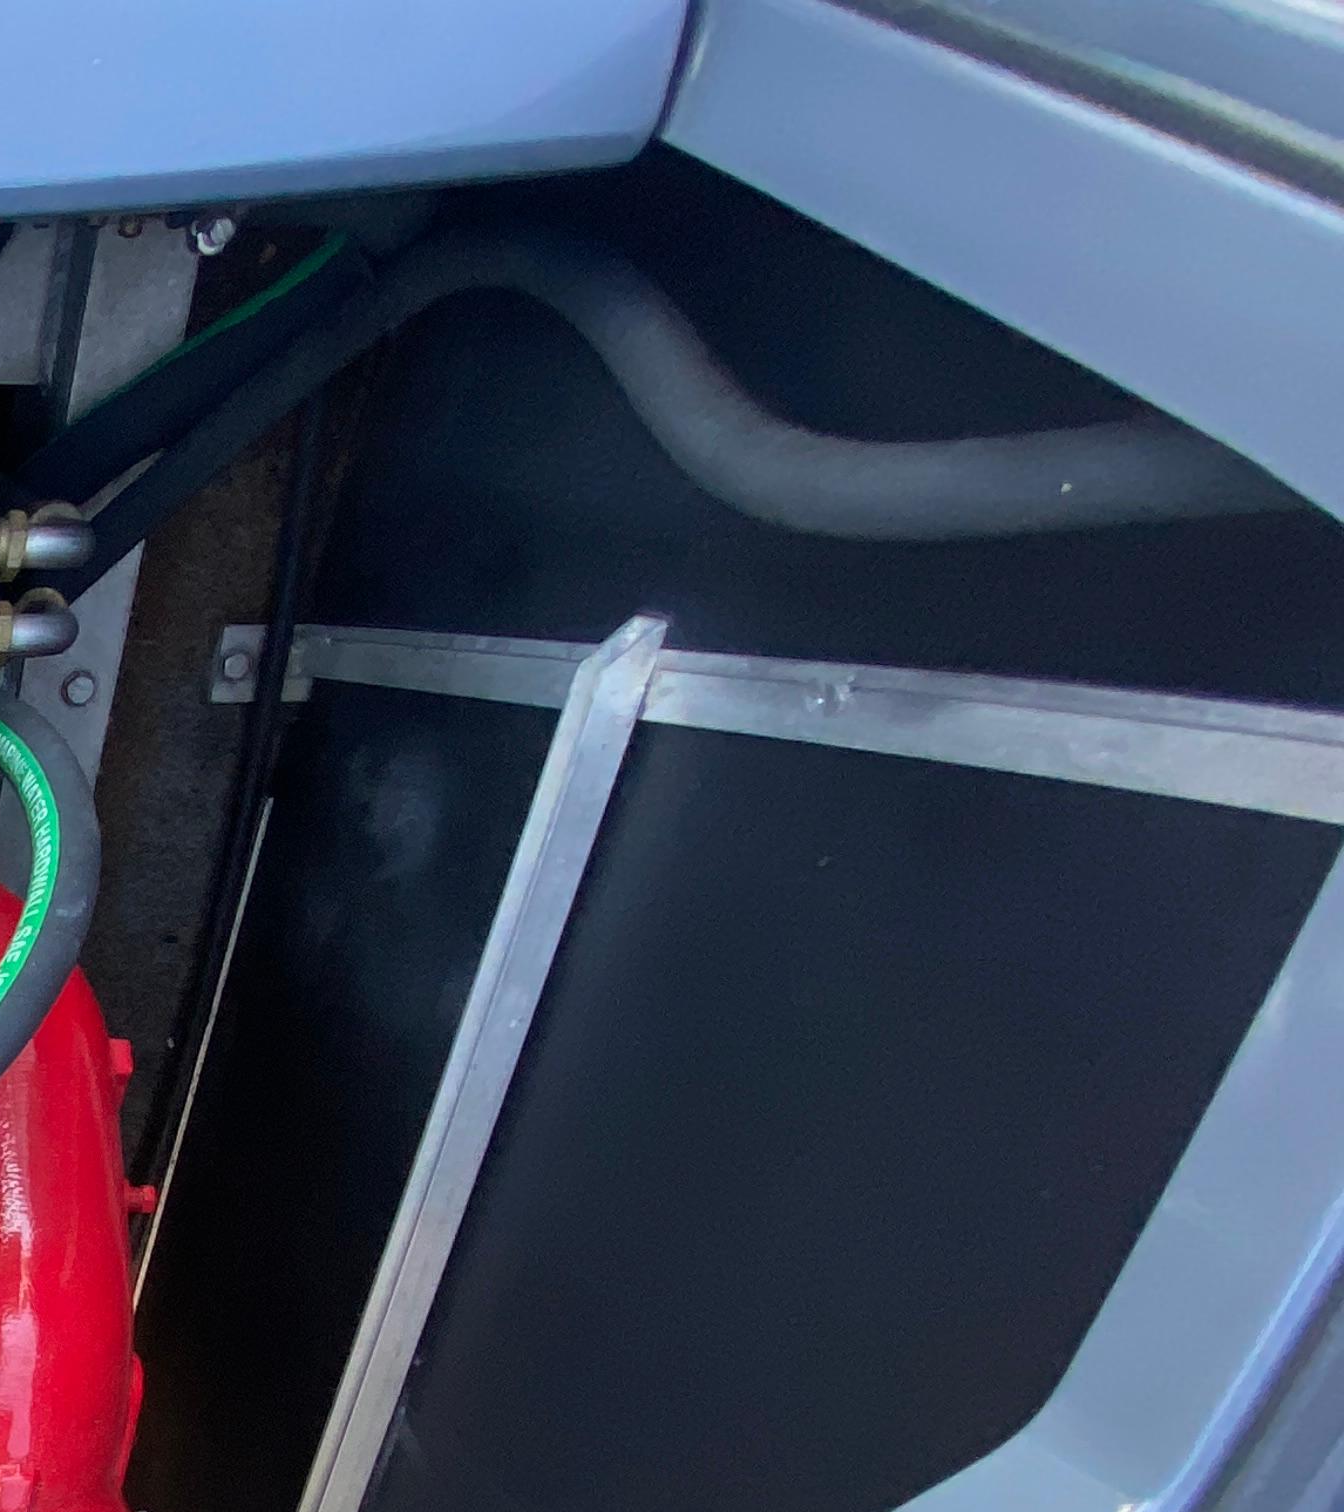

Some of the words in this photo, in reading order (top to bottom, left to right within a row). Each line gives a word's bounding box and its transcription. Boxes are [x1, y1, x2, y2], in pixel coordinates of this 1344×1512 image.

[21, 770, 48, 823] WATER
[21, 821, 52, 918] HARDWALL
[9, 926, 33, 963] SAE
